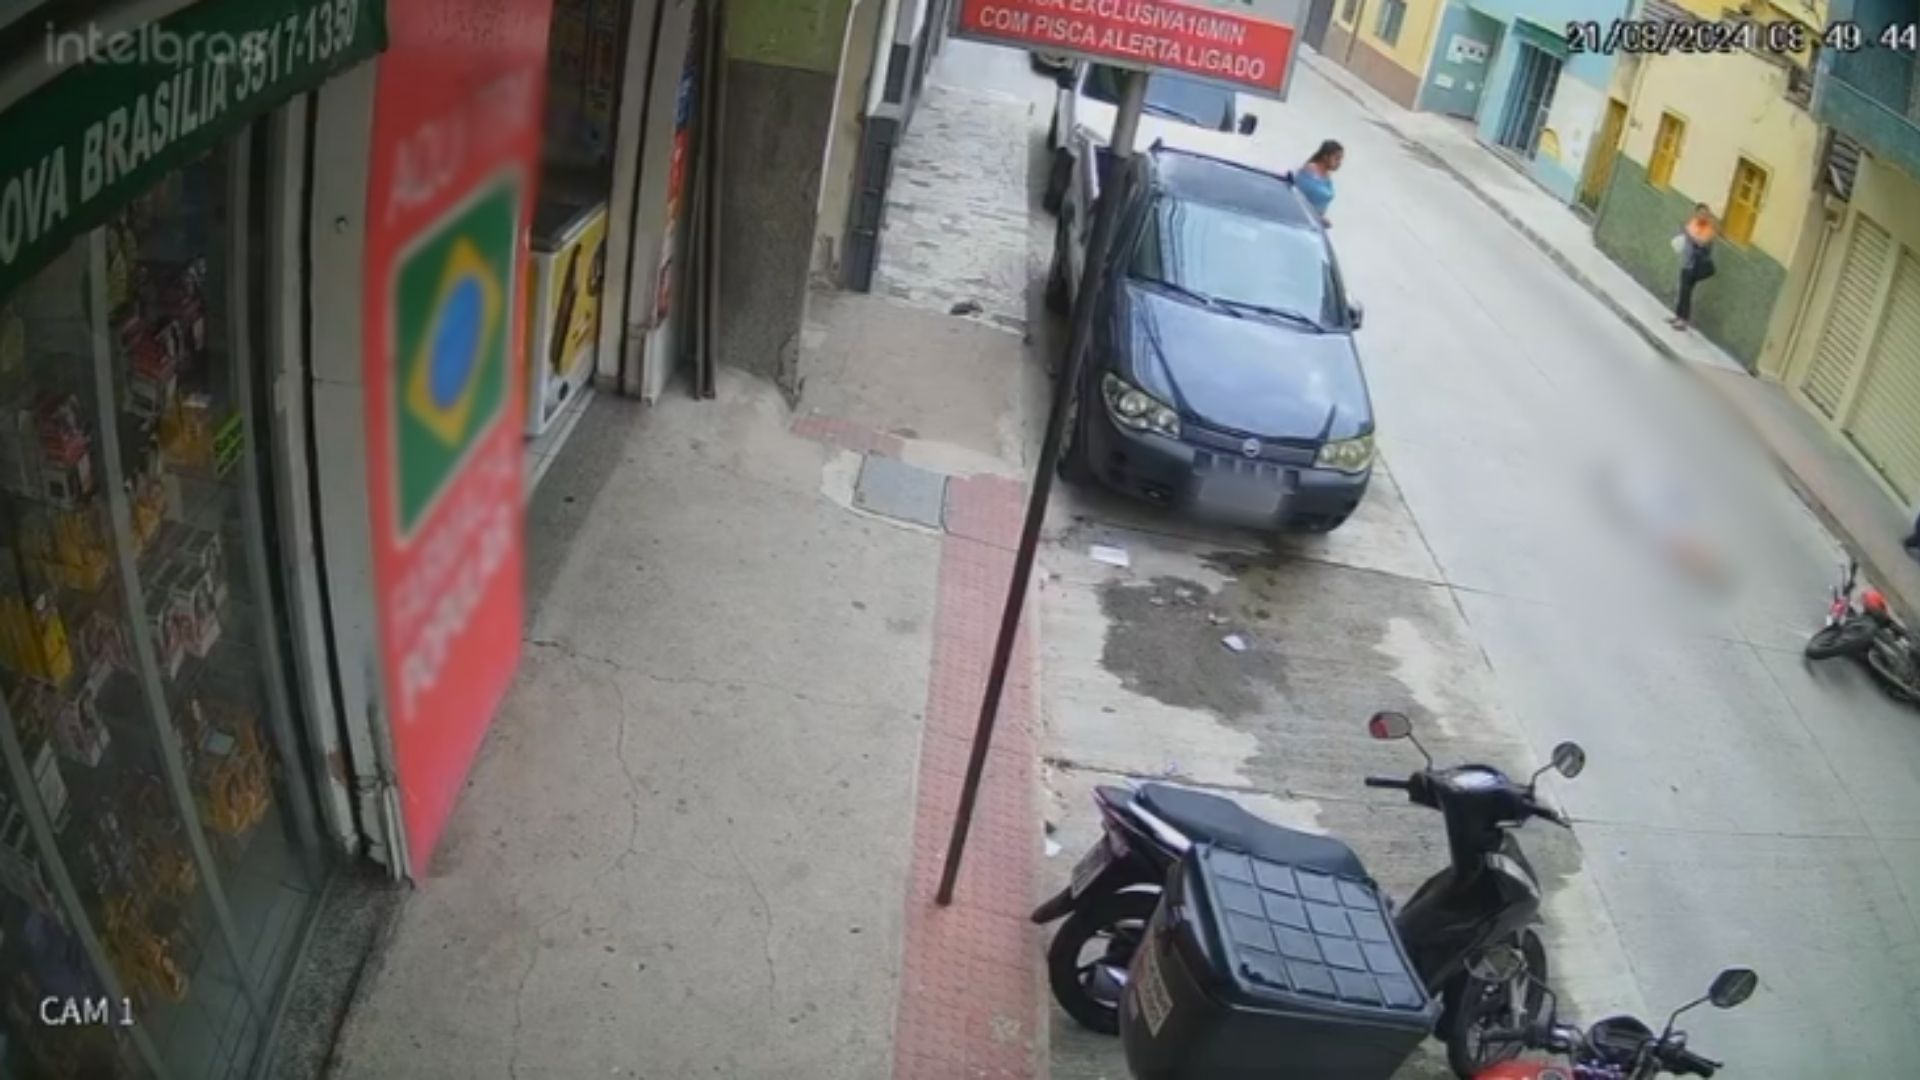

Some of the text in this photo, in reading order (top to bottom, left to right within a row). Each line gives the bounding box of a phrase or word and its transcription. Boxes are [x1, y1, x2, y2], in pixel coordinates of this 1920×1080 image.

[979, 6, 1265, 80] COM PISCA ALERTA LIGADO
